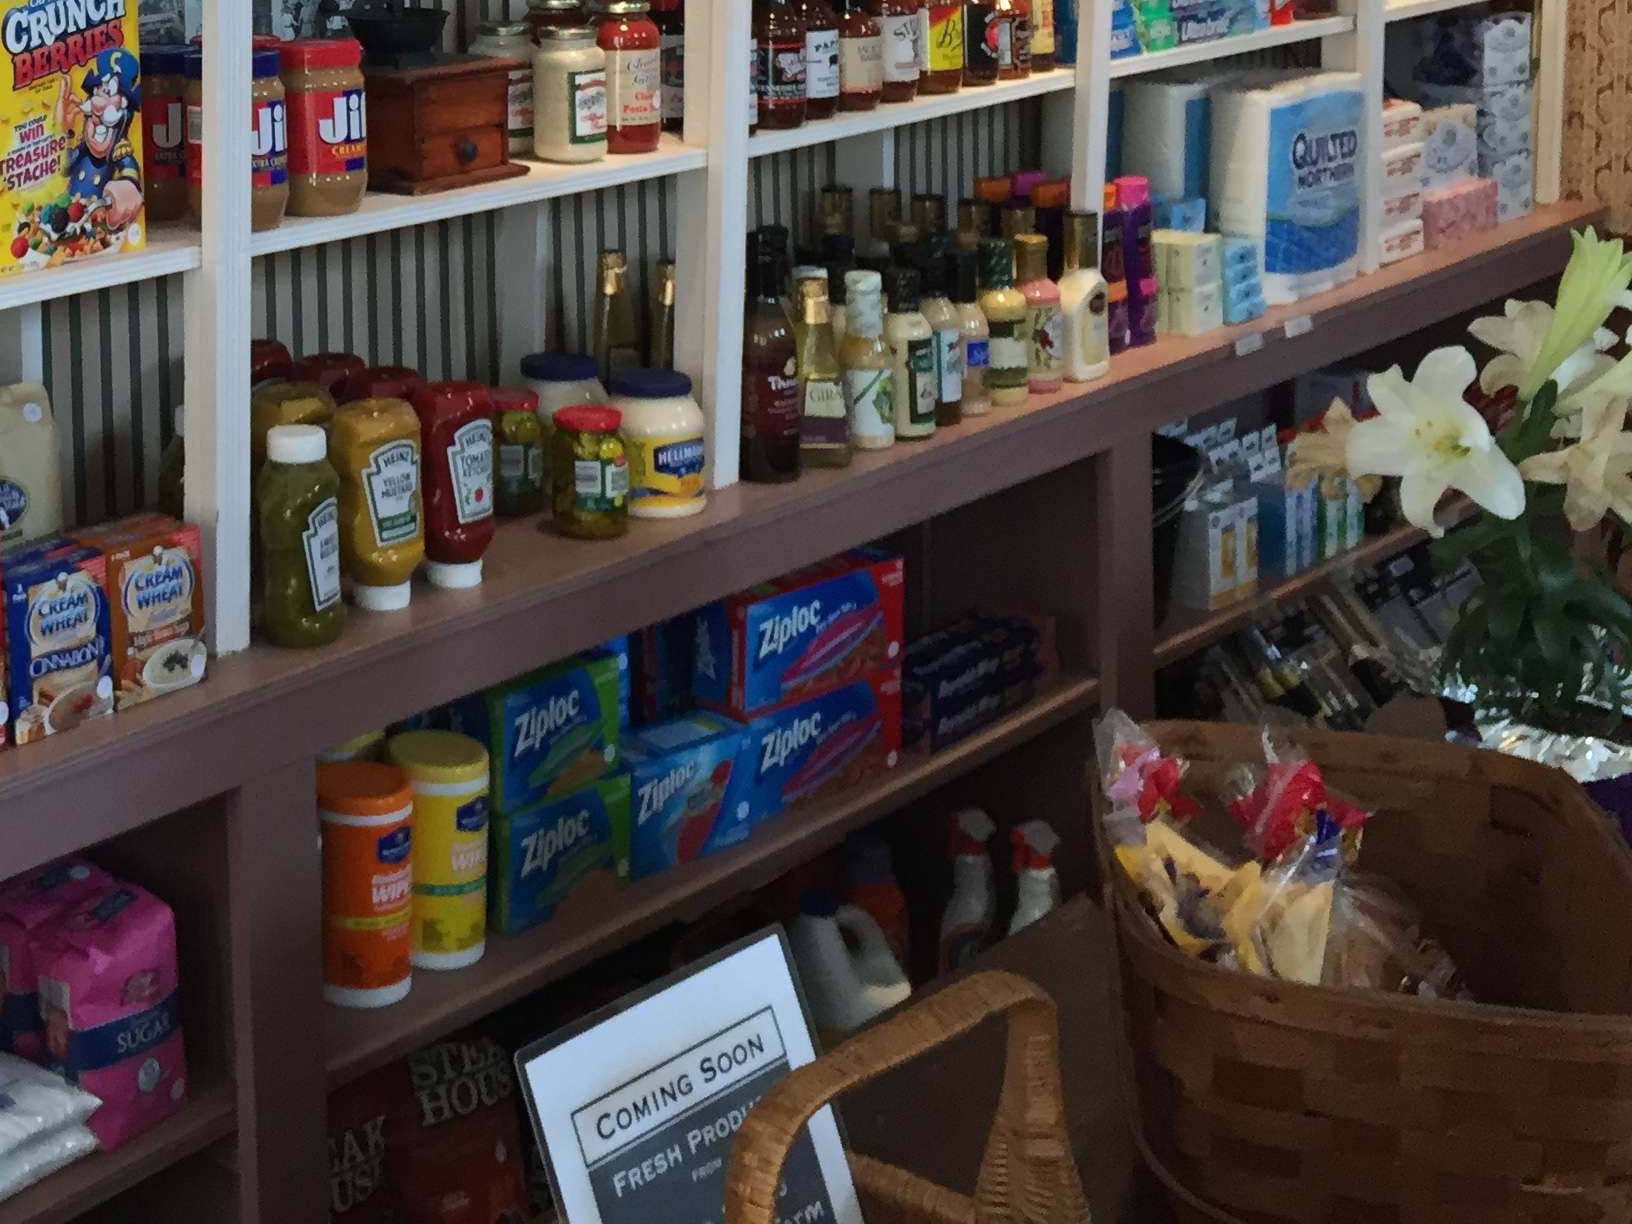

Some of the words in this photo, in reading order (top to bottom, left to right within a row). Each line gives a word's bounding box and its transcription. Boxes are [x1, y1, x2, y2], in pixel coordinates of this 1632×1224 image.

[13, 19, 124, 91] BERRIES
[332, 144, 367, 156] CREAM
[383, 450, 410, 468] HEINZ
[460, 450, 490, 467] TOMAT
[380, 482, 413, 498] MUSTARD
[134, 564, 183, 591] CREAM
[136, 584, 183, 610] WHEAT
[38, 591, 89, 616] CREAM
[40, 612, 89, 637] WHEAT
[757, 595, 822, 660] Ziploc
[30, 637, 105, 677] CINNABON
[513, 685, 581, 758] Ziploc
[759, 709, 824, 774] Ziploc
[636, 757, 697, 827] Ziploc
[520, 804, 591, 879] Ziploc
[372, 881, 412, 905] WIP
[116, 1015, 177, 1057] SUGAR
[408, 1041, 504, 1088] STEA
[596, 1074, 694, 1142] COMING
[699, 1032, 766, 1086] SOON
[613, 1145, 683, 1198] FRESH
[687, 1095, 761, 1152] PROD
